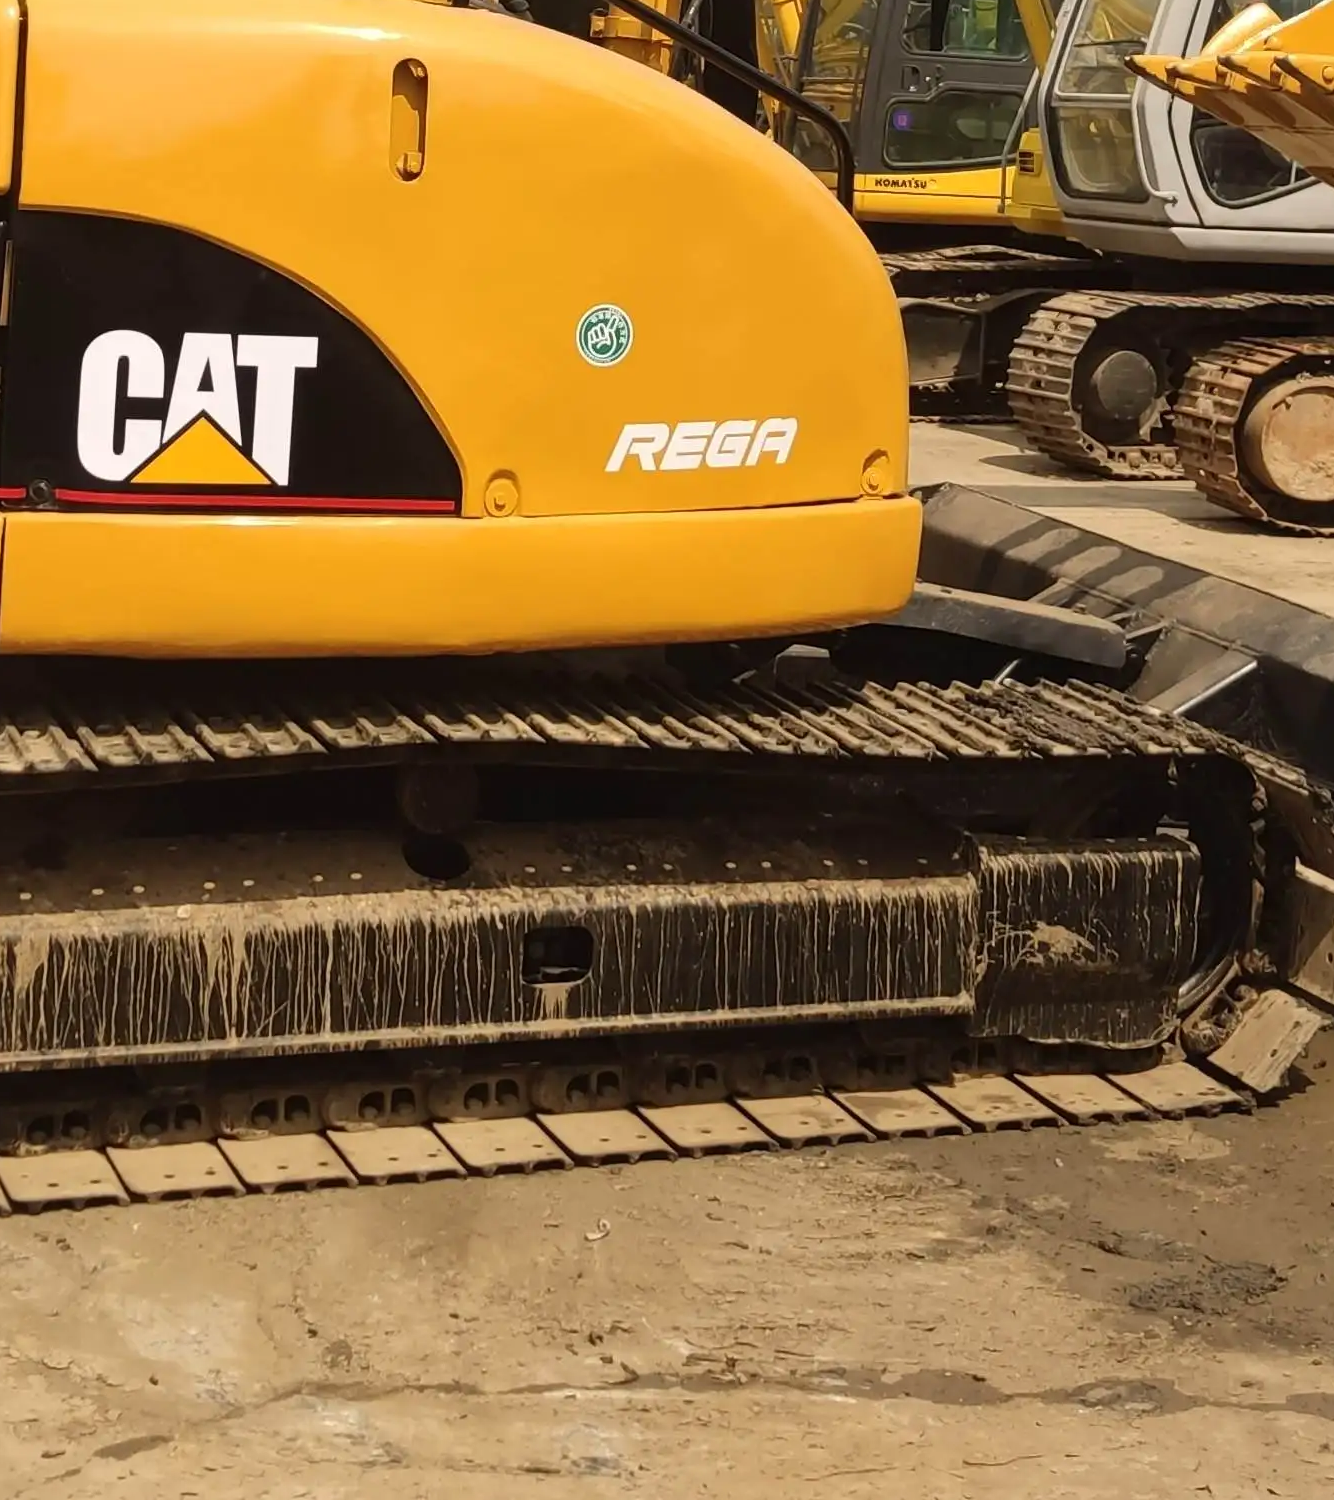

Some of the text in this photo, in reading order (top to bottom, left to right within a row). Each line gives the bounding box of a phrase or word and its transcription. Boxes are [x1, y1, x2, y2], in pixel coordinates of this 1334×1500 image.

[874, 177, 927, 189] KOMATSU
[77, 329, 319, 486] CAT
[604, 417, 798, 472] REGA
